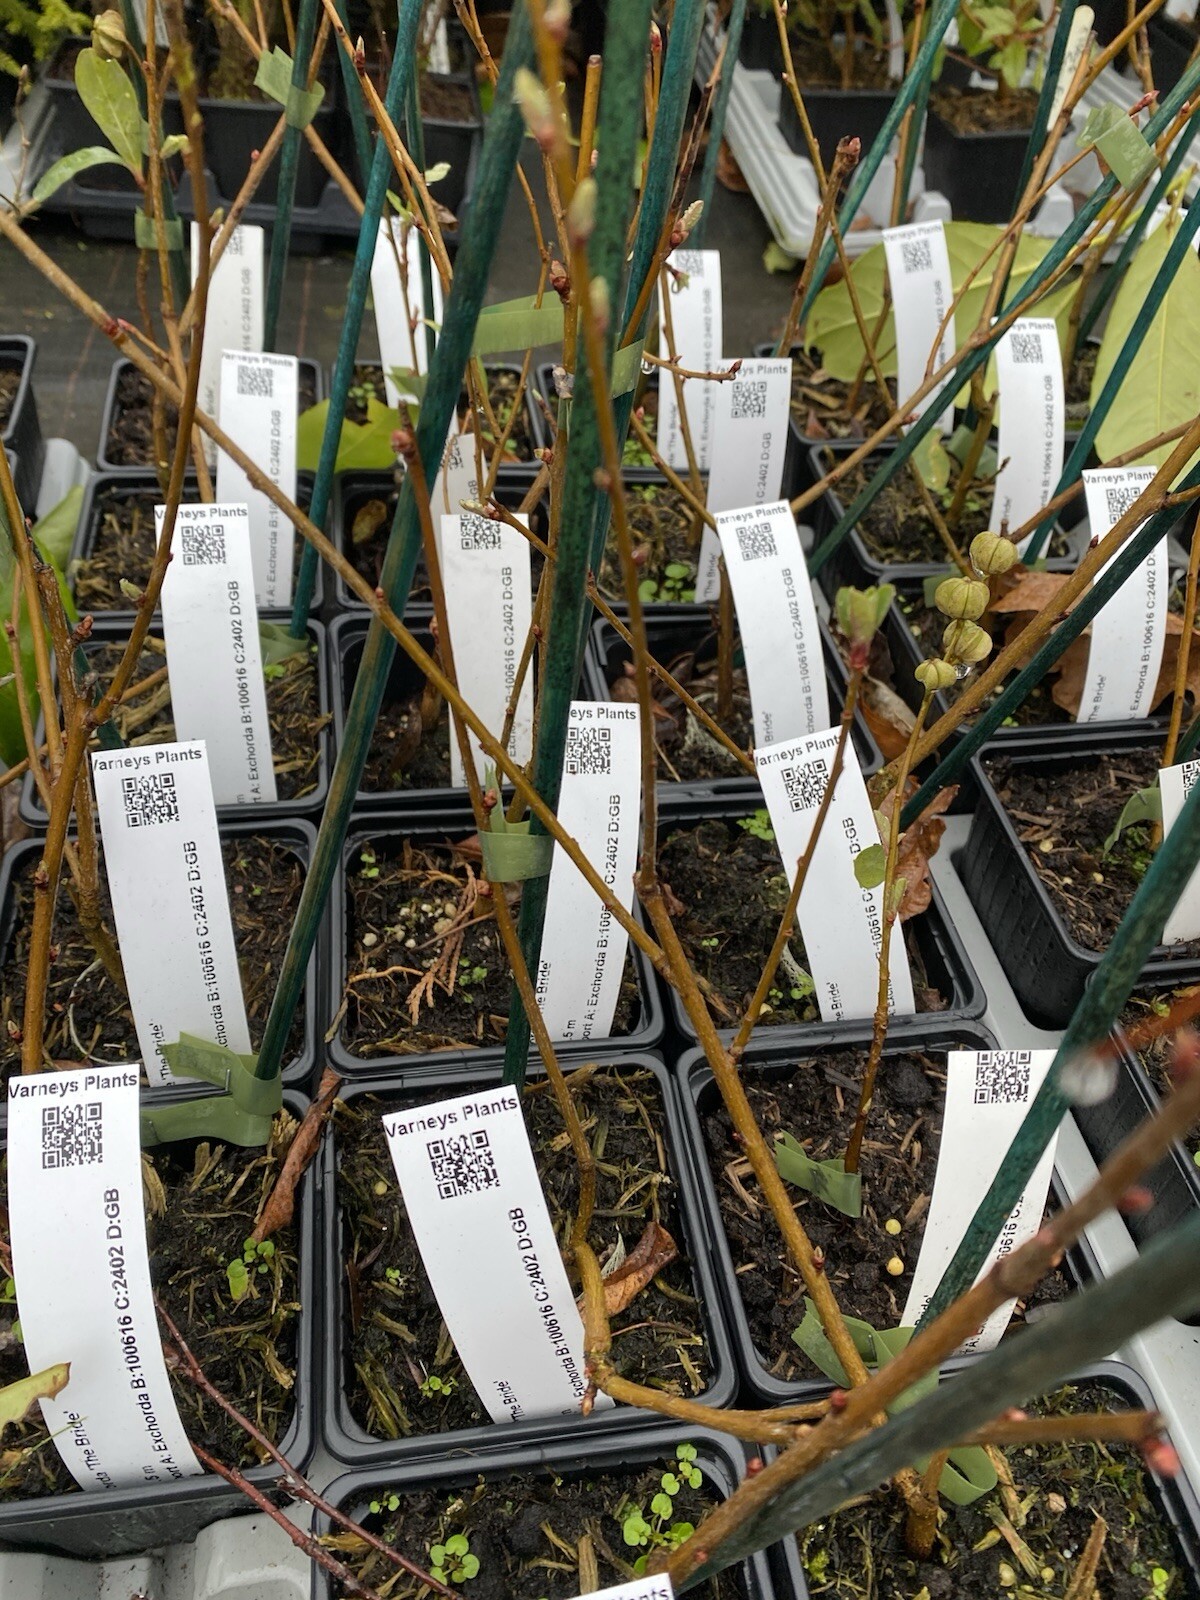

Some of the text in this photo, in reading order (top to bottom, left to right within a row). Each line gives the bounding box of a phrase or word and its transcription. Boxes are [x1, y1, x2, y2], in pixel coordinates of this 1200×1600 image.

[757, 365, 788, 374] Plants
[760, 432, 772, 460] D:GB
[209, 507, 248, 518] Plants
[755, 506, 788, 518] Plants
[228, 580, 241, 615] D:GB
[501, 566, 513, 600] D:GB
[781, 568, 797, 598] D:GB
[1146, 570, 1156, 608] C:2402
[503, 604, 515, 645] C:2402
[788, 600, 804, 640] C:2402
[1142, 612, 1155, 661] B:100616
[231, 619, 245, 664] C:2402
[796, 643, 812, 694] B:100616
[1130, 664, 1149, 711] Exchorda
[235, 667, 253, 724] B:100616
[597, 707, 637, 719] Plants
[155, 748, 203, 764] Plants
[241, 727, 259, 781] Exchorda
[805, 734, 842, 753] Plant
[608, 794, 621, 832] D:GB
[842, 817, 861, 854] D:GB
[184, 841, 201, 882] D:GB
[605, 837, 619, 884] C:2402
[189, 885, 209, 937] C:2402
[199, 940, 220, 1002] B:100616
[587, 952, 607, 1006] Exchorda
[826, 982, 842, 1010] Bride'
[9, 1072, 138, 1099] Varneys Plants
[385, 1097, 518, 1138] Varneys Plants
[104, 1188, 122, 1240] D:GB
[508, 1207, 533, 1251] D:GB
[108, 1245, 130, 1310] C:2402
[522, 1253, 550, 1302] C:2402
[539, 1305, 570, 1357] B:100616
[117, 1315, 146, 1389] B:100616
[493, 1380, 517, 1405] Bride'
[63, 1410, 91, 1447] Bride'
[136, 1393, 168, 1452] Exchorda
[159, 1453, 176, 1465] A:
